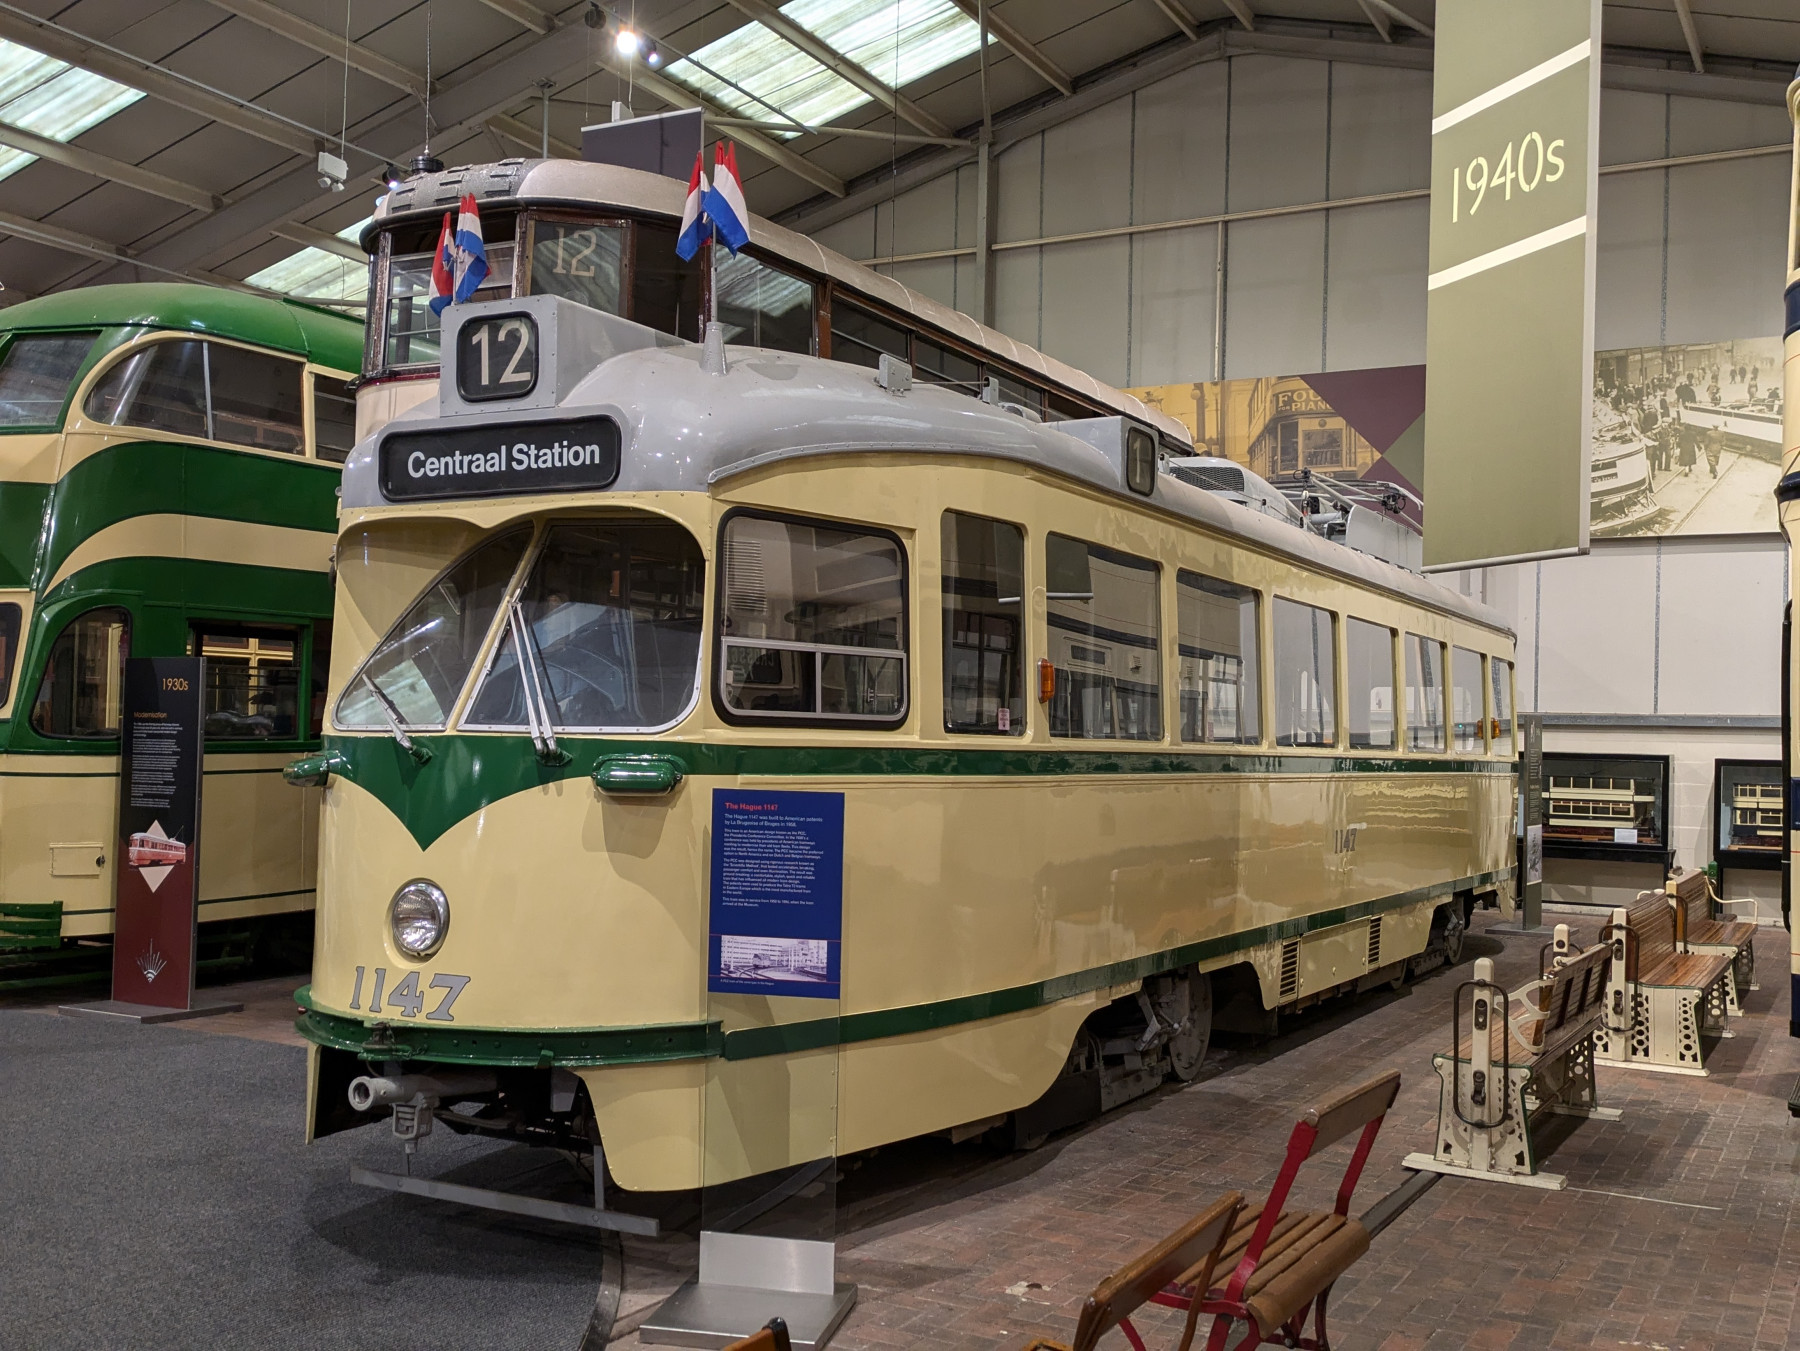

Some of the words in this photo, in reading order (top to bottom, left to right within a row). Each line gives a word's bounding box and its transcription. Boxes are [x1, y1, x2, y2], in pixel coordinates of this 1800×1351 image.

[1452, 131, 1565, 223] 1940s
[552, 227, 597, 277] 12
[471, 320, 531, 386] 12
[407, 445, 506, 479] Centraal
[511, 440, 600, 471] Station
[162, 678, 189, 691] 1930s
[133, 711, 168, 719] Modernisation
[1334, 828, 1358, 854] 1147
[349, 965, 472, 1022] 1147
